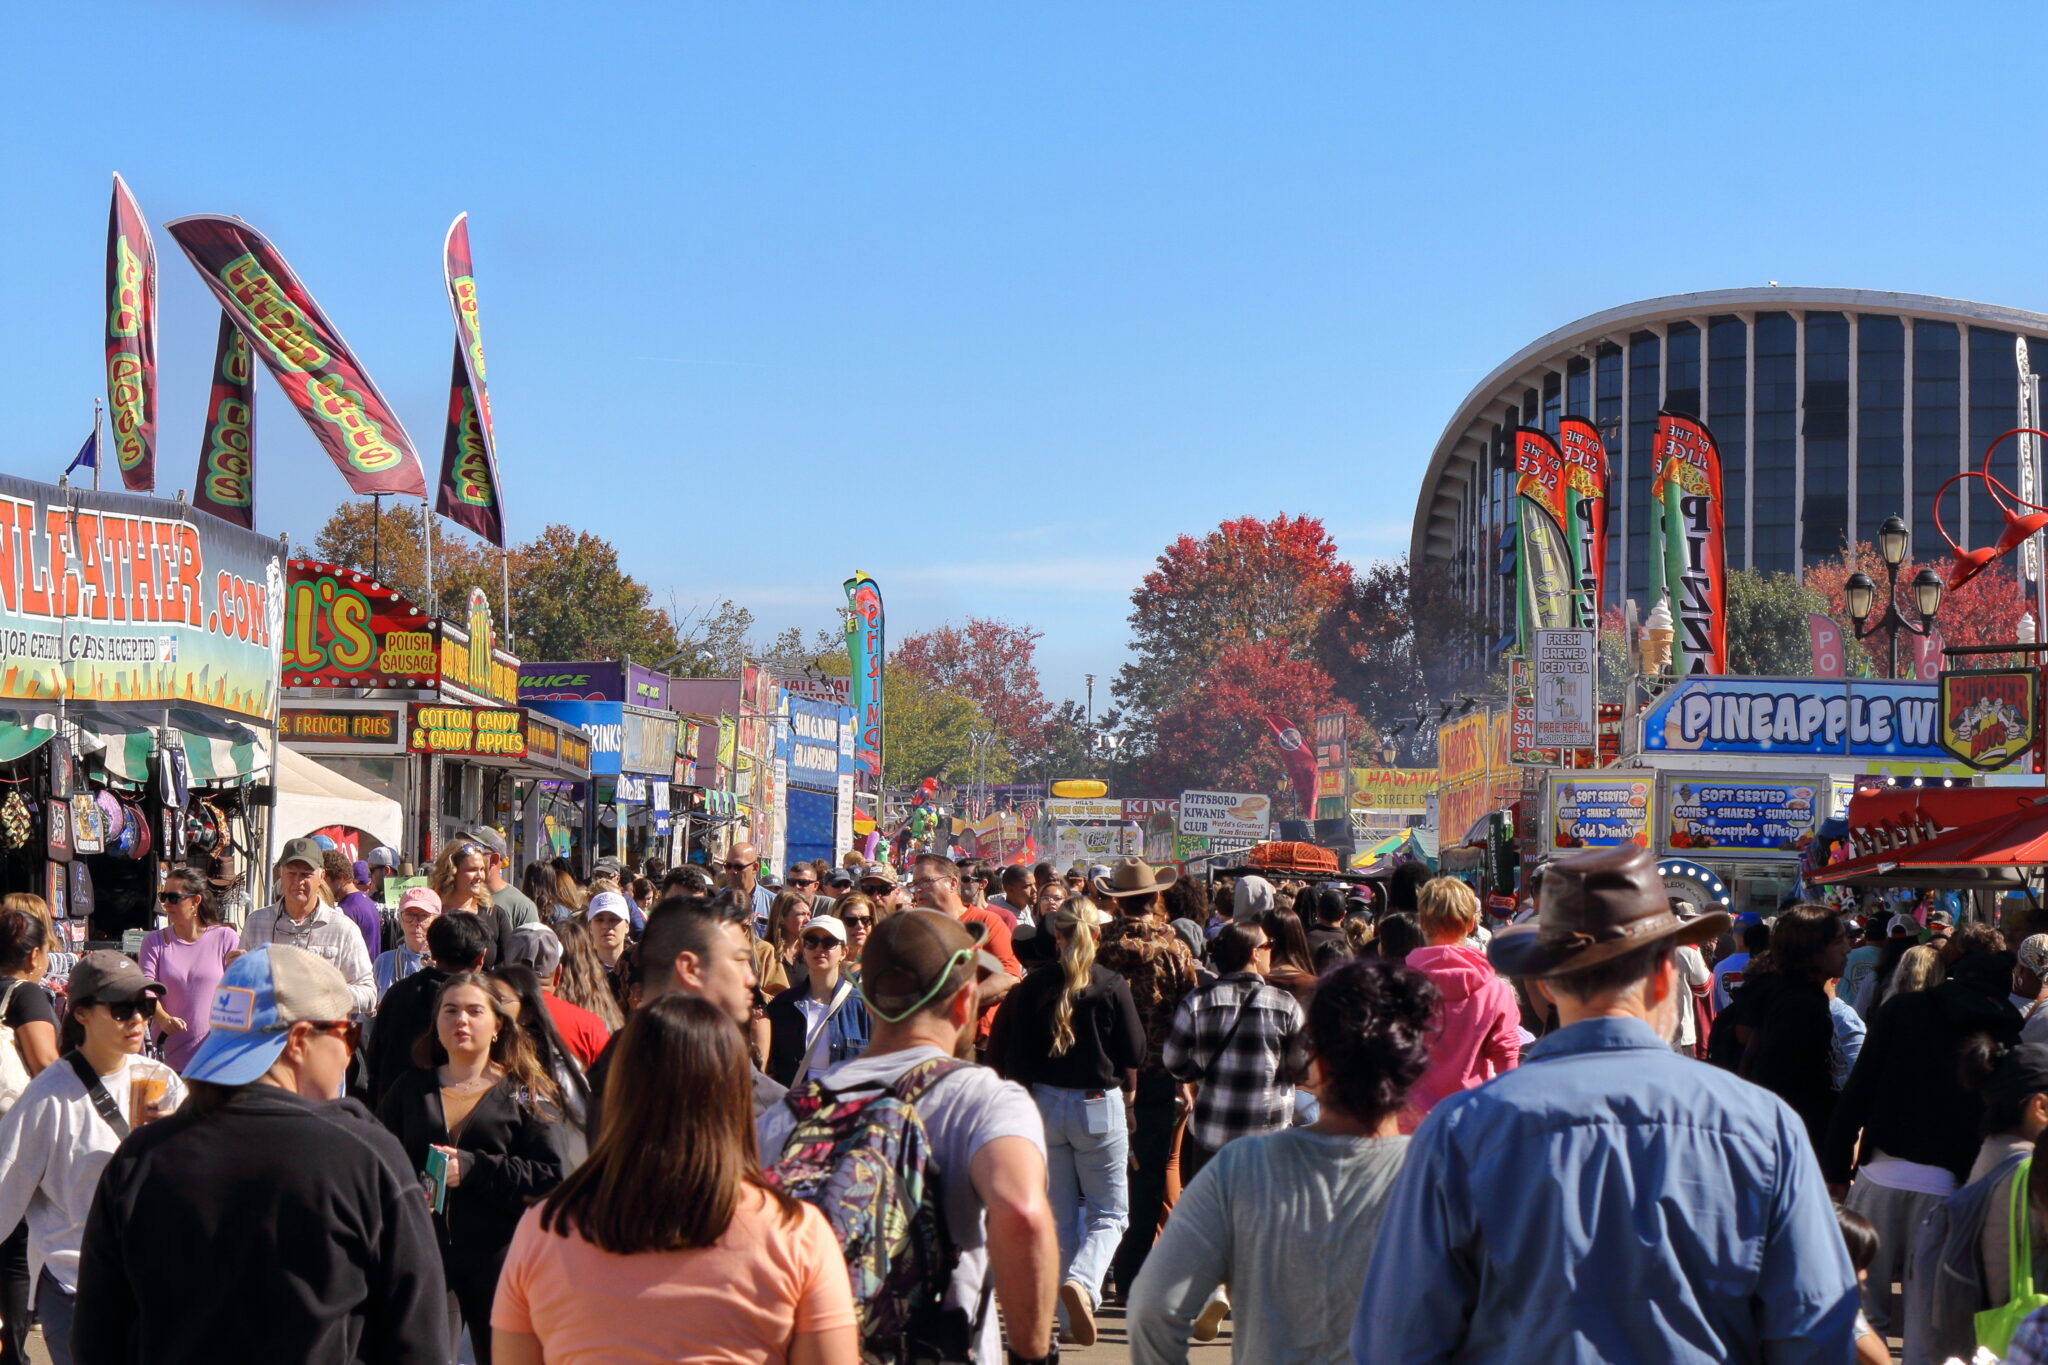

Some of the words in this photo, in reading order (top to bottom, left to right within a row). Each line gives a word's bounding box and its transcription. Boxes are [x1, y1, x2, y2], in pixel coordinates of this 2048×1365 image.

[111, 357, 143, 465] DOGS
[312, 378, 397, 469] FRIES
[213, 403, 248, 502] DOGS
[388, 633, 431, 653] POLISH
[1546, 633, 1581, 646] FRESH
[108, 638, 155, 661] ACCEPTED
[1542, 648, 1586, 660] BREWED
[382, 653, 436, 672] SAUSAGE
[1540, 661, 1565, 674] ICED
[1567, 661, 1590, 674] TEA
[294, 716, 347, 736] FRENCH
[352, 716, 392, 736] FRIES
[418, 708, 472, 730] COTTON
[475, 711, 520, 732] CANDY
[1682, 692, 1893, 747] PINEAPPLE
[1538, 722, 1562, 733] FREE
[1563, 722, 1591, 734] REFILL
[413, 729, 425, 749] &
[430, 730, 472, 750] CANDY
[475, 733, 525, 752] APPLES
[1185, 793, 1237, 806] PITTSBORO
[1377, 794, 1416, 804] STREET
[1576, 790, 1597, 804] SOFT
[1598, 790, 1630, 804] SERVED
[1701, 789, 1734, 804] SOFT
[1735, 789, 1786, 805] SERVED
[1184, 807, 1226, 819] KIWANIS
[1560, 807, 1581, 819] CONES
[1586, 807, 1611, 819] SHAKES
[1616, 807, 1645, 820] SUNDAES
[1674, 807, 1709, 819] CONES
[1717, 808, 1756, 819] SHAKES
[1765, 808, 1812, 821] SUNDAES
[1184, 821, 1208, 832] CLUB
[1570, 823, 1597, 838] Cold
[1598, 823, 1633, 839] Drinks
[1688, 820, 1760, 838] Pineapple
[1762, 821, 1799, 841] Whip
